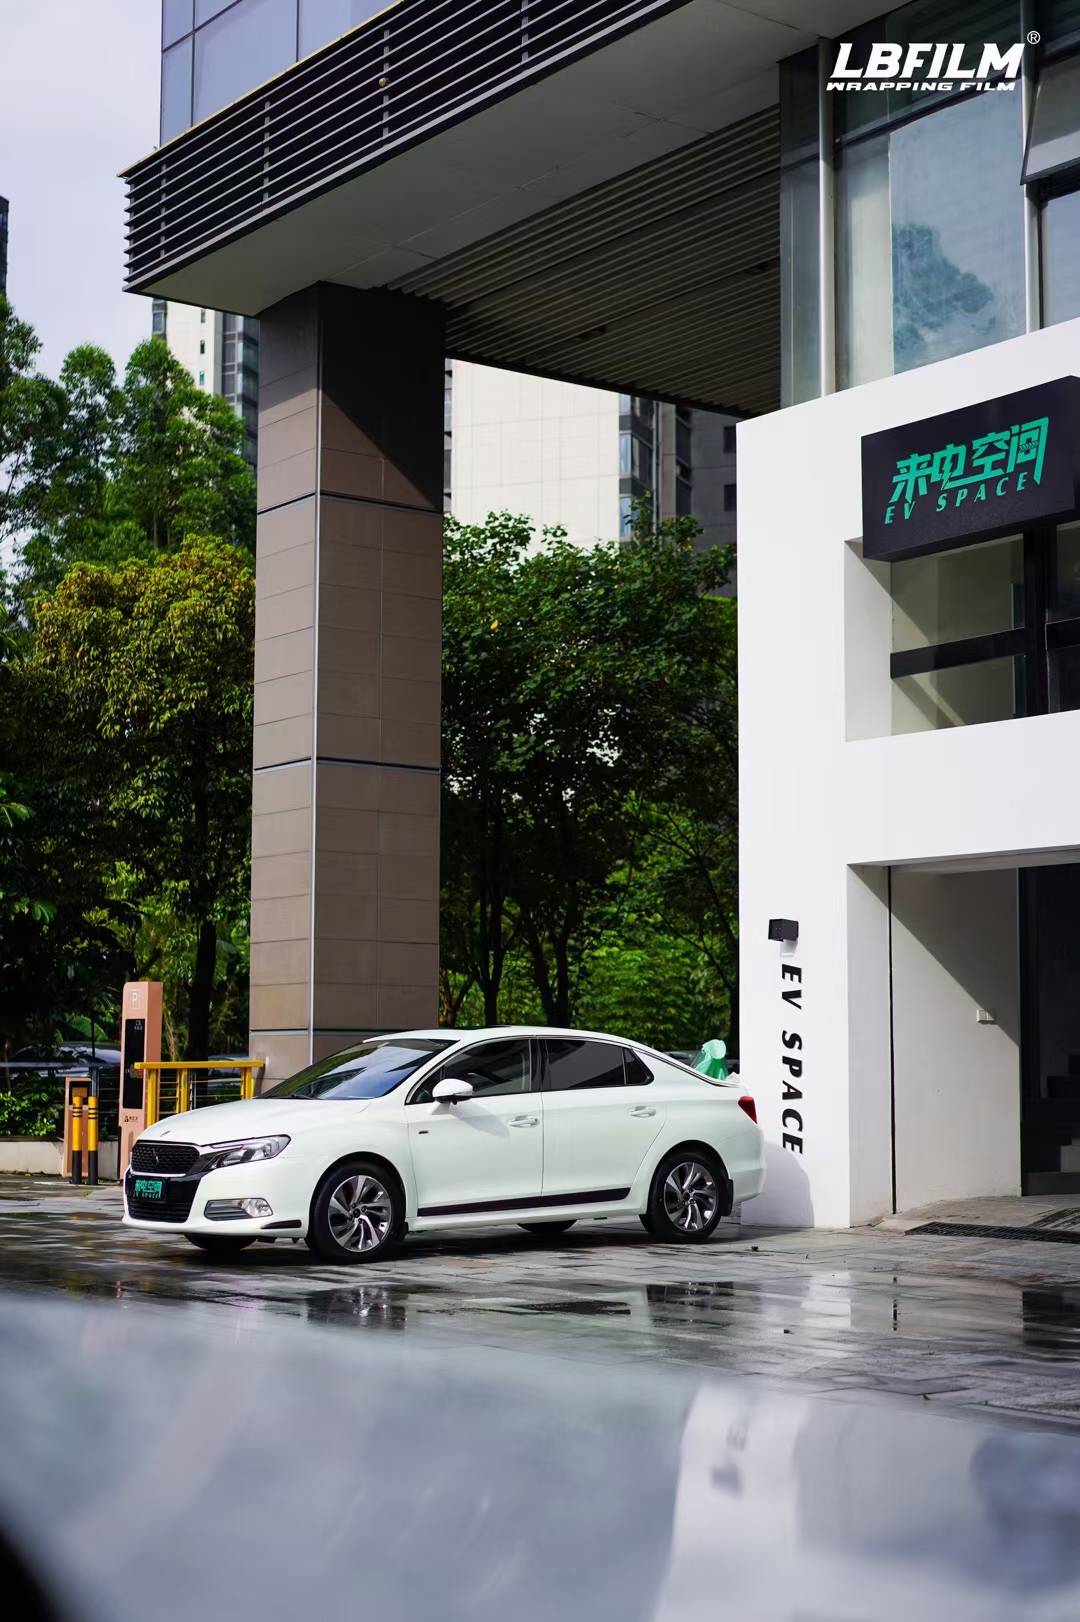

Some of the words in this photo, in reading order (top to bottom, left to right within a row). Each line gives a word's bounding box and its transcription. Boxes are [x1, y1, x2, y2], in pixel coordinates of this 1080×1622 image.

[889, 417, 1049, 504] 来电空间
[884, 501, 916, 525] EV
[936, 472, 1028, 512] SPACE
[781, 963, 802, 1010] EV
[781, 1030, 803, 1155] SPACE
